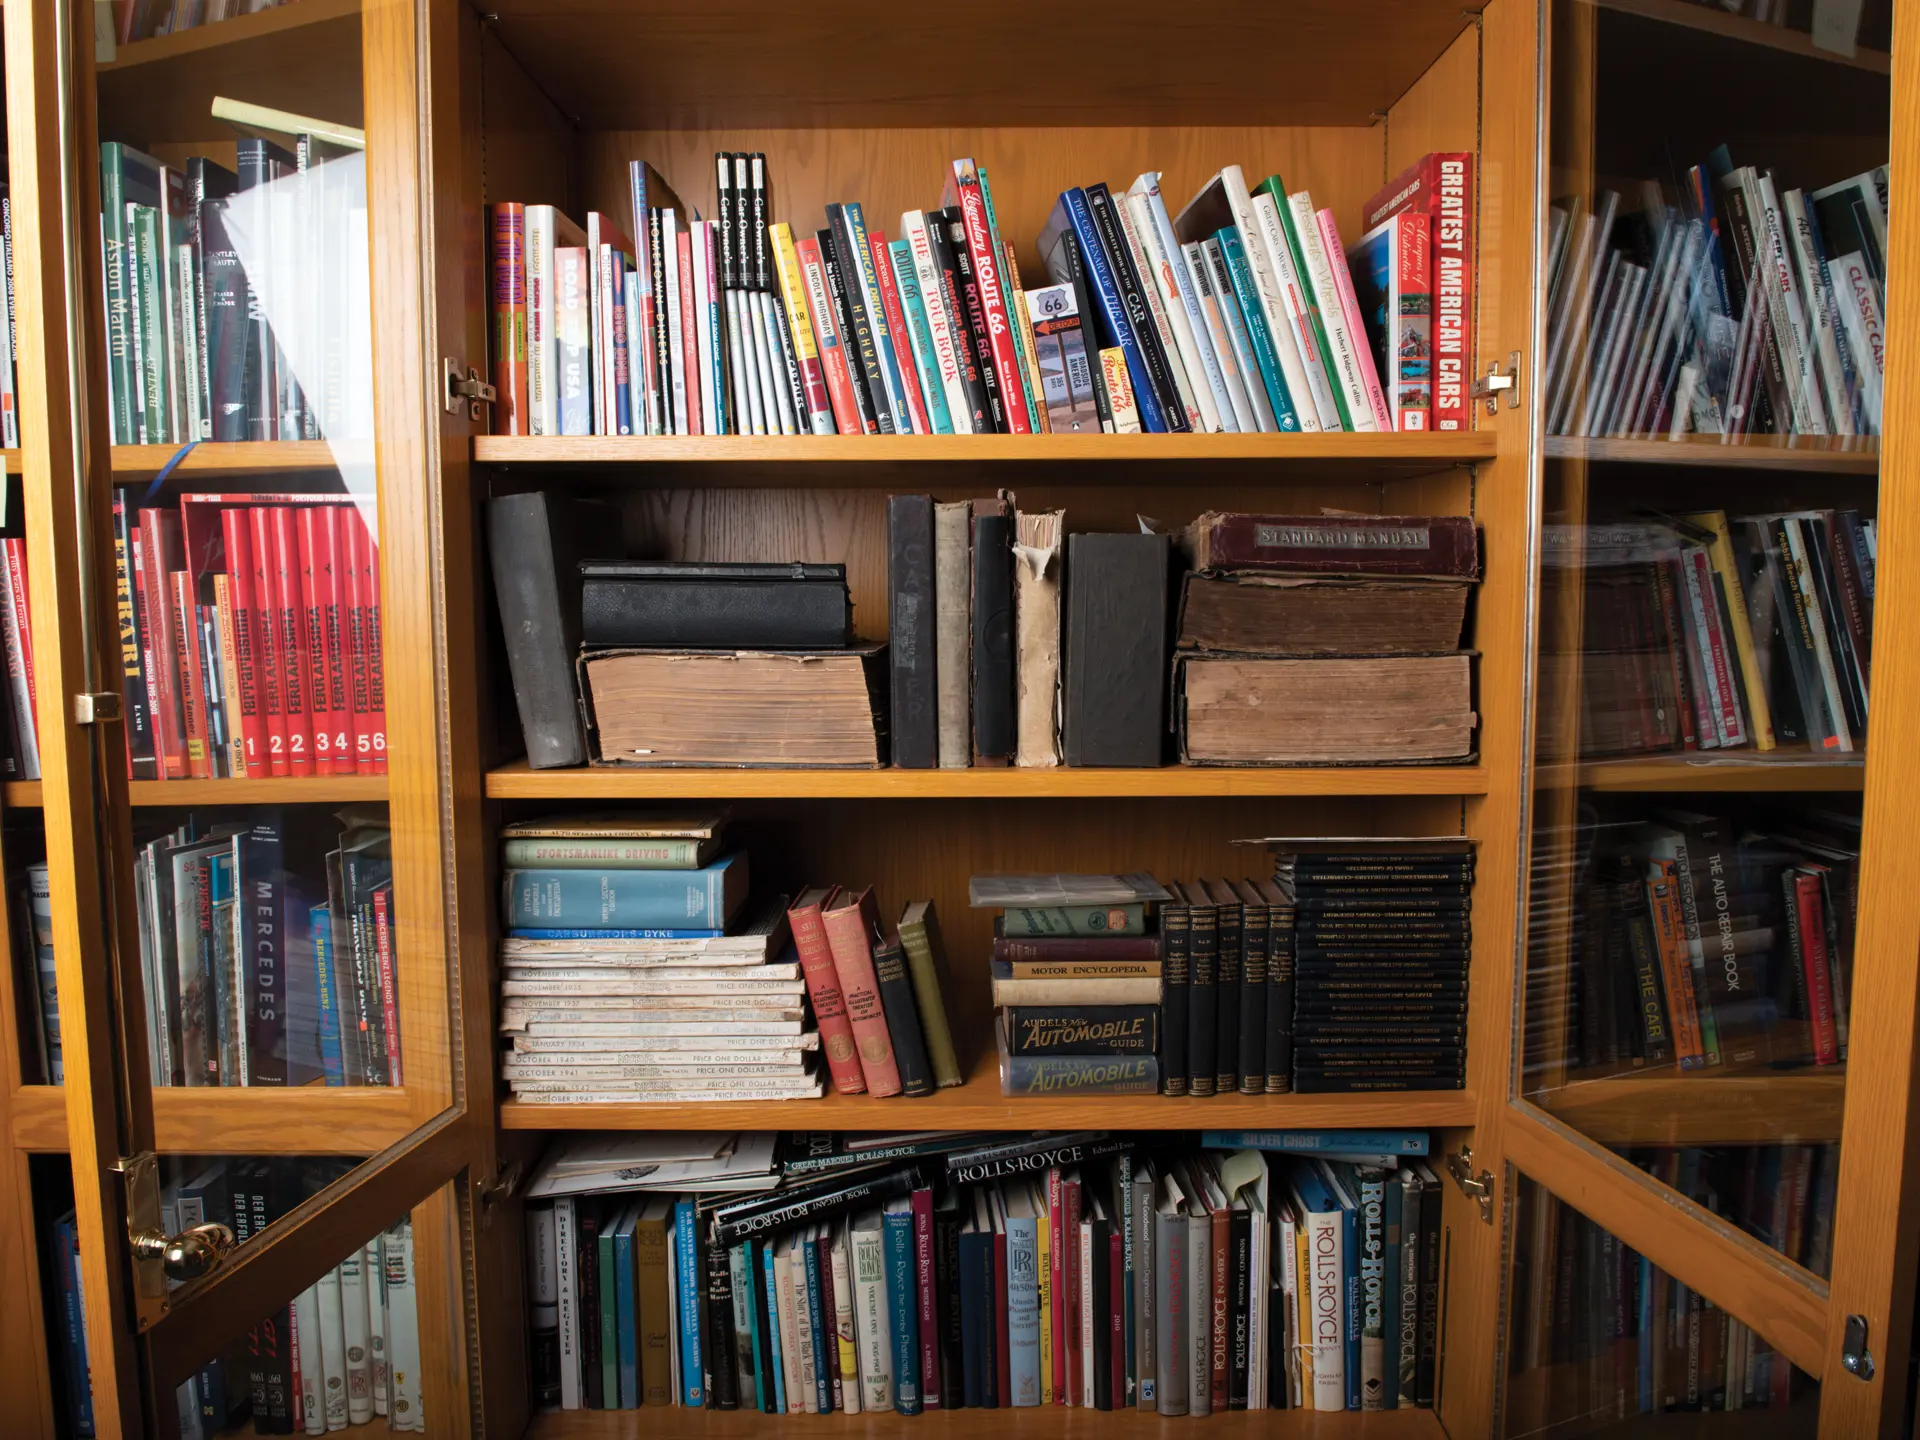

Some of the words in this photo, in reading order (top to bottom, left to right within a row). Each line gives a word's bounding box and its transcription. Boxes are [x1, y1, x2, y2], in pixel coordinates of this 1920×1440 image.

[720, 198, 730, 218] Car
[738, 198, 747, 218] Car
[754, 198, 763, 218] Car
[851, 208, 859, 221] THE
[1440, 161, 1463, 251] GREATEST
[722, 220, 732, 264] Owner's
[739, 220, 749, 264] Owner's
[755, 220, 766, 264] Owner's
[1105, 220, 1117, 249] COMPLETE
[1400, 221, 1414, 281] Distinction
[107, 239, 125, 291] Aston
[650, 218, 664, 304] HOMETOWN
[854, 225, 876, 285] AMERICAN
[964, 191, 987, 251] Legendary
[978, 256, 1000, 308] ROUTE
[990, 313, 1006, 334] 66
[1114, 252, 1123, 269] BOOK
[1190, 250, 1202, 262] THE
[1209, 247, 1220, 259] THE
[565, 259, 578, 310] ROAD
[602, 255, 611, 289] DINERS
[680, 253, 691, 305] TRAILER
[1074, 198, 1087, 218] THE
[1082, 221, 1106, 273] CENTENARY
[1101, 276, 1111, 288] OF
[1106, 292, 1122, 319] THE
[1116, 321, 1132, 346] CAR
[1123, 278, 1132, 289] THE
[1194, 264, 1211, 296] SURVIVORS
[1213, 261, 1231, 294] SURVIVORS
[808, 264, 823, 298] LINCOLN
[816, 301, 832, 337] HIGHWAY
[911, 226, 929, 260] THE
[920, 268, 930, 279] 66
[926, 288, 944, 333] TOUR
[938, 338, 958, 383] BOOK
[1045, 300, 1062, 312] 66
[1127, 292, 1144, 323] CAR
[1440, 256, 1462, 352] AMERICAN
[1764, 207, 1784, 260] CONCEPT
[1778, 264, 1791, 293] CARS
[1791, 322, 1804, 355] Jonathan
[1798, 356, 1808, 376] Wood
[1848, 266, 1877, 331] CLASSIC
[111, 300, 130, 356] Martin
[614, 306, 626, 343] RETRO
[868, 287, 888, 336] DRIVE-IN
[959, 253, 970, 275] SCOTT
[965, 284, 985, 334] ROUTE
[977, 339, 991, 358] 66
[984, 367, 996, 387] KELLY
[656, 314, 667, 365] DINERS
[684, 309, 694, 357] TRAVEL
[853, 305, 879, 379] HIGHWAY
[566, 363, 580, 399] USA
[616, 348, 628, 384] DINER
[787, 360, 798, 378] CAR
[1057, 376, 1066, 388] 365
[1070, 358, 1082, 388] AMERICA
[1078, 357, 1089, 386] ROADSIDE
[1102, 355, 1119, 393] Route
[1111, 395, 1126, 413] 66
[1117, 359, 1134, 409] Traveling
[1439, 359, 1461, 409] CARS
[790, 381, 804, 409] TALES
[1263, 529, 1348, 543] STANDARD
[1358, 531, 1421, 544] MANUAL
[114, 539, 140, 678] FERRARI
[1777, 531, 1790, 561] Pebble
[1784, 562, 1798, 590] Beach
[1792, 593, 1813, 650] Remembered
[261, 608, 281, 716] FERRARISSIMA
[283, 608, 302, 715] FERRARISSIMA
[309, 606, 327, 713] FERRARISSIMA
[328, 603, 345, 711] FERRARISSIMA
[350, 606, 367, 714] FERRARISSIMA
[367, 605, 384, 713] FERRARISSIMA
[133, 705, 143, 731] LAMM
[246, 738, 254, 756] 1
[270, 736, 283, 754] 2
[291, 734, 304, 752] 2
[316, 733, 328, 751] 3
[335, 732, 347, 750] 4
[357, 735, 370, 752] 5
[373, 733, 386, 751] 6
[236, 749, 245, 771] OSPREY
[536, 848, 619, 859] SPORTSMANLIKE
[625, 848, 669, 860] DRIVING
[1707, 854, 1722, 875] THE
[197, 867, 210, 931] MASERATI
[1712, 878, 1728, 910] AUTO
[377, 912, 389, 970] MERCEDES-BENZ
[1717, 912, 1734, 951] REPAIR
[257, 882, 274, 1021] MERCEDES
[1073, 965, 1147, 974] ENCYCLOPEDIA
[315, 939, 329, 1010] MERCEDES-BENZ
[382, 972, 392, 1004] LEGENDS
[1637, 963, 1655, 999] THE
[1724, 953, 1740, 992] BOOK
[1022, 1019, 1144, 1049] AUTOMOBILE
[1643, 1002, 1662, 1037] CAR
[1110, 1039, 1144, 1047] GUIDE
[1028, 1060, 1148, 1093] AUTOMOBILE
[791, 1161, 816, 1170] GREAT
[818, 1155, 854, 1167] MARQUES
[856, 1146, 915, 1161] ROLLS-ROYCE
[956, 1147, 1084, 1183] ROLLS-ROYCE
[734, 1204, 808, 1235] ROLLS-ROYCE
[1361, 1181, 1384, 1329] ROLLS-ROYCE
[1408, 1233, 1416, 1244] the
[919, 1234, 930, 1284] ROLLS-ROYCE
[1407, 1249, 1415, 1281] american
[795, 1284, 806, 1296] The
[1042, 1253, 1050, 1308] ROLLS-ROYCE
[1316, 1226, 1337, 1344] ROLLS-ROYCE
[796, 1297, 808, 1315] Story
[1401, 1284, 1416, 1360] ROLLS-ROYCE
[801, 1328, 810, 1338] the
[802, 1341, 812, 1360] Black
[1236, 1314, 1246, 1369] ROLLS-ROYCE
[803, 1363, 814, 1385] Beauty
[1196, 1336, 1206, 1397] ROLLS-ROYCE
